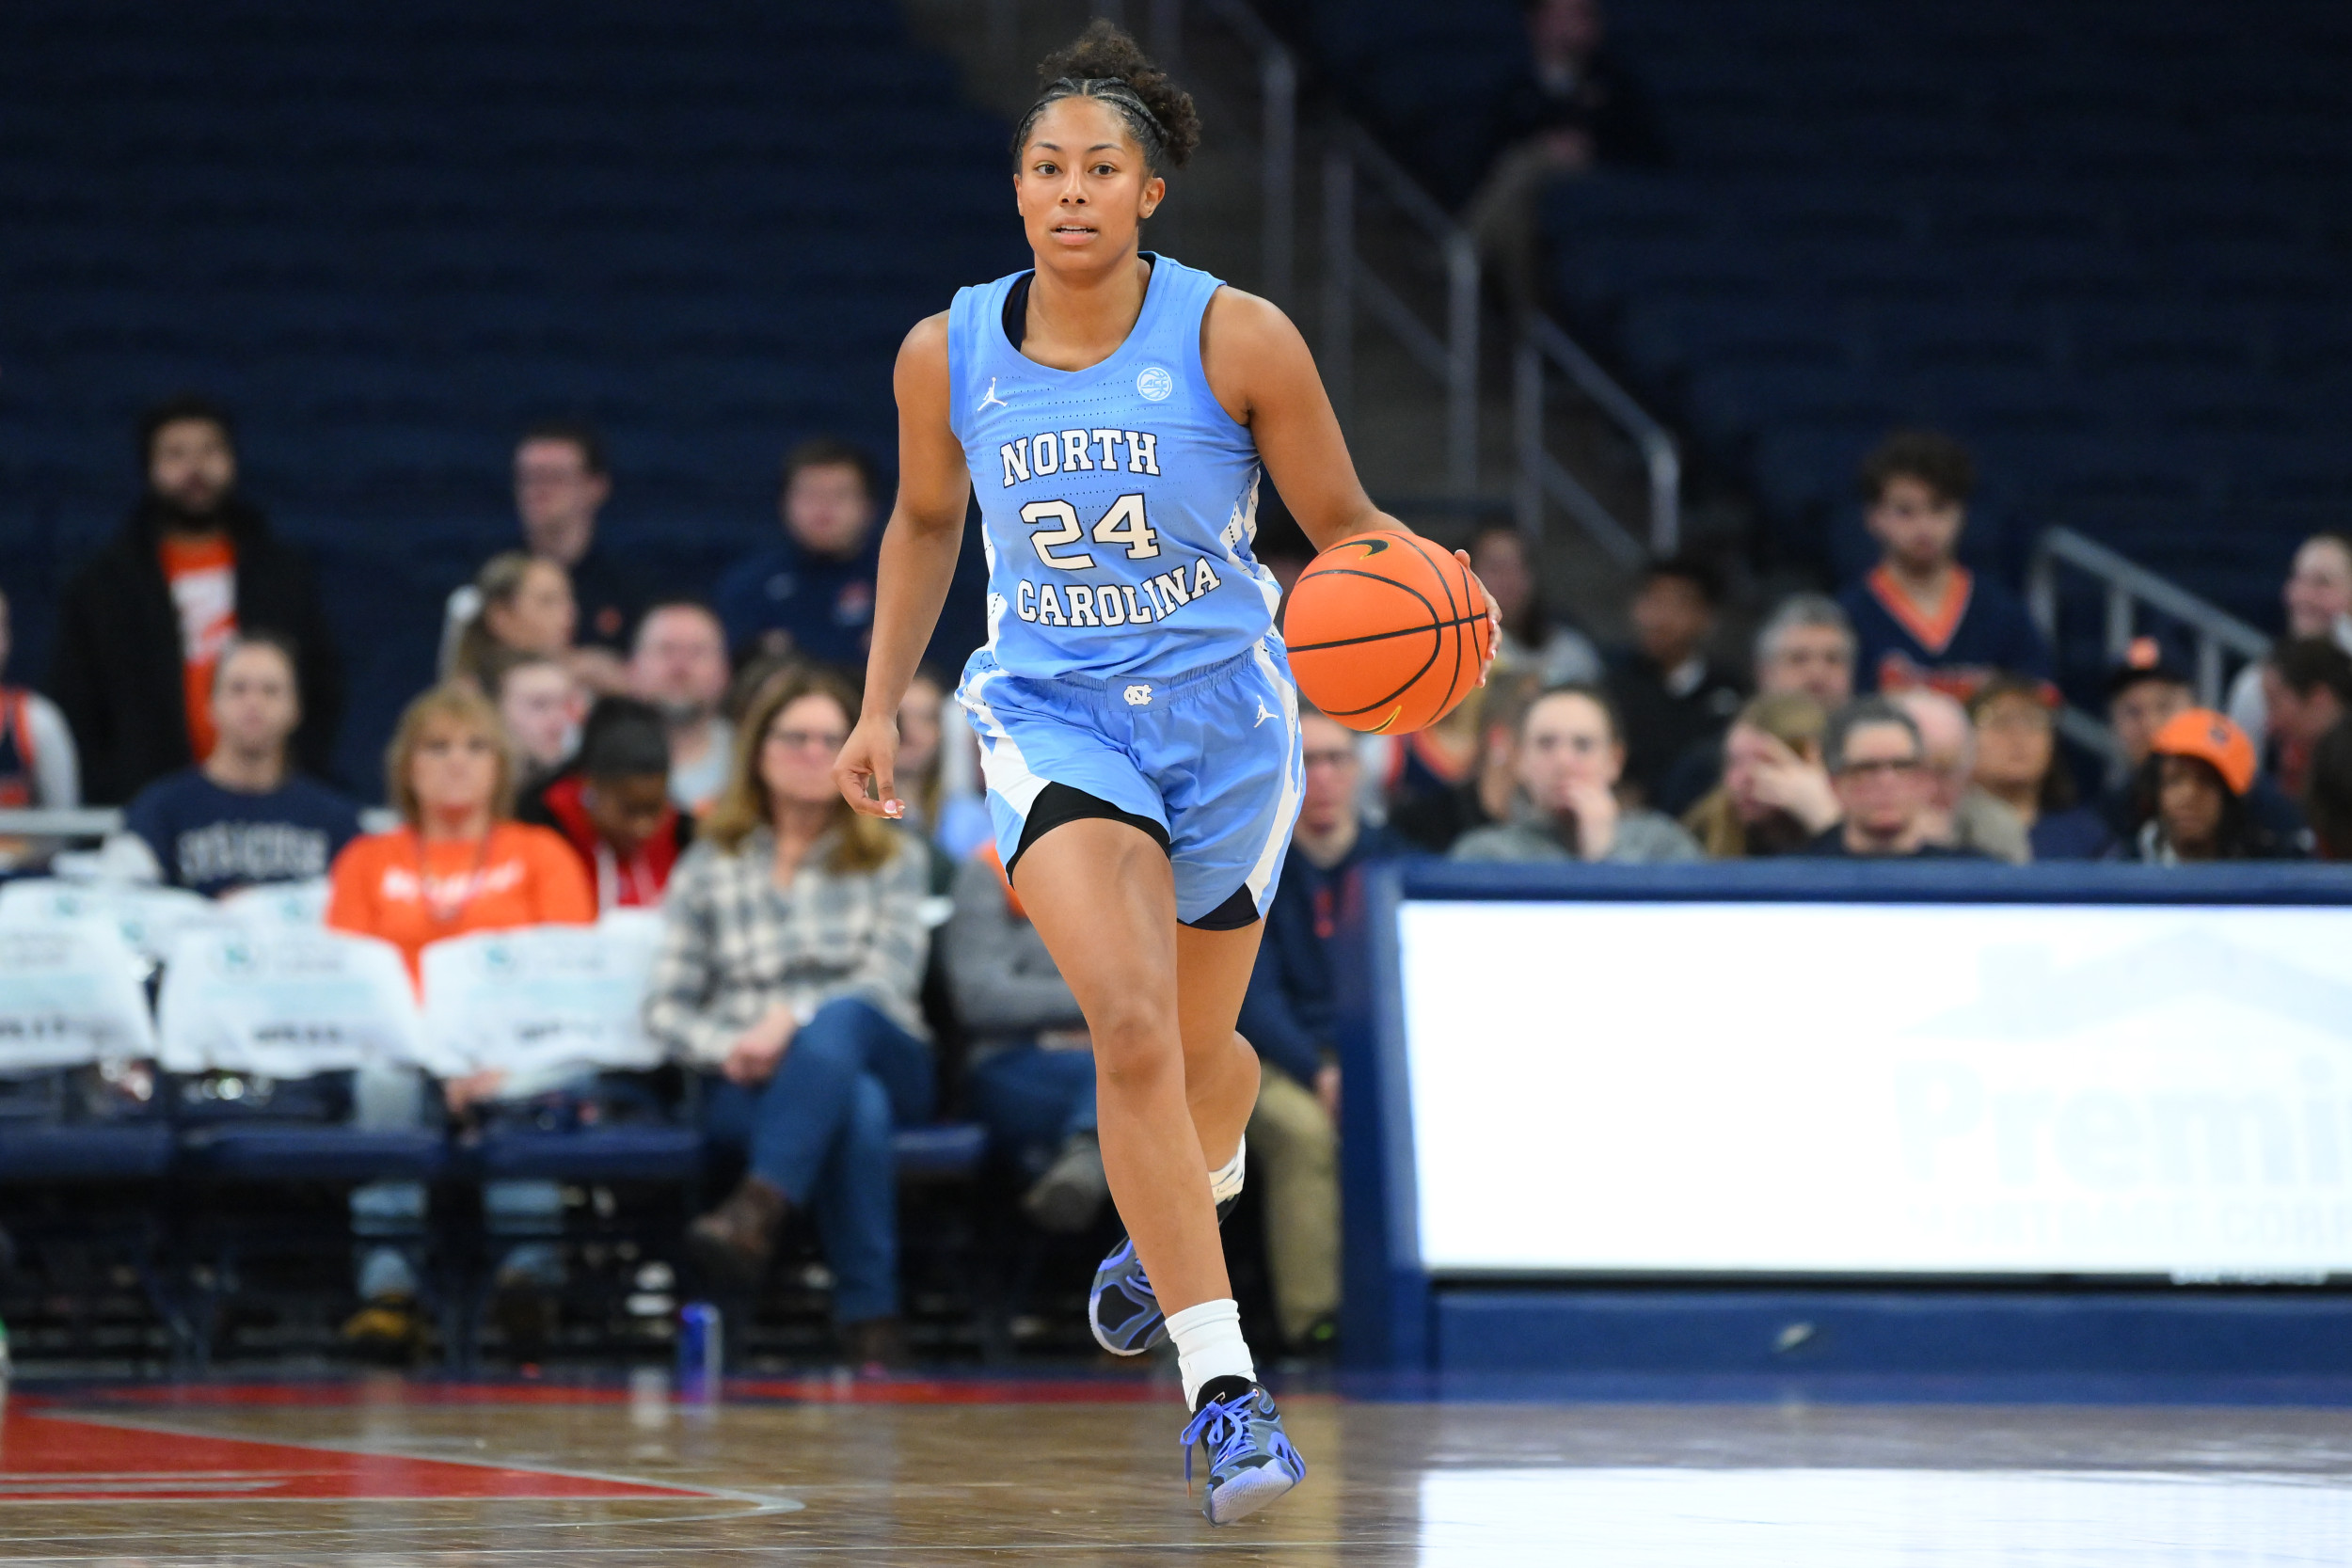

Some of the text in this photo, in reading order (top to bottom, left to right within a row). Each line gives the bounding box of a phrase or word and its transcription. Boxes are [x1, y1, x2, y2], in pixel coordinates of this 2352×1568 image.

[1001, 429, 1161, 487] NORTH
[1019, 493, 1162, 571] 24
[1016, 556, 1222, 627] CAROLINA
[1894, 1055, 2352, 1192] Premi
